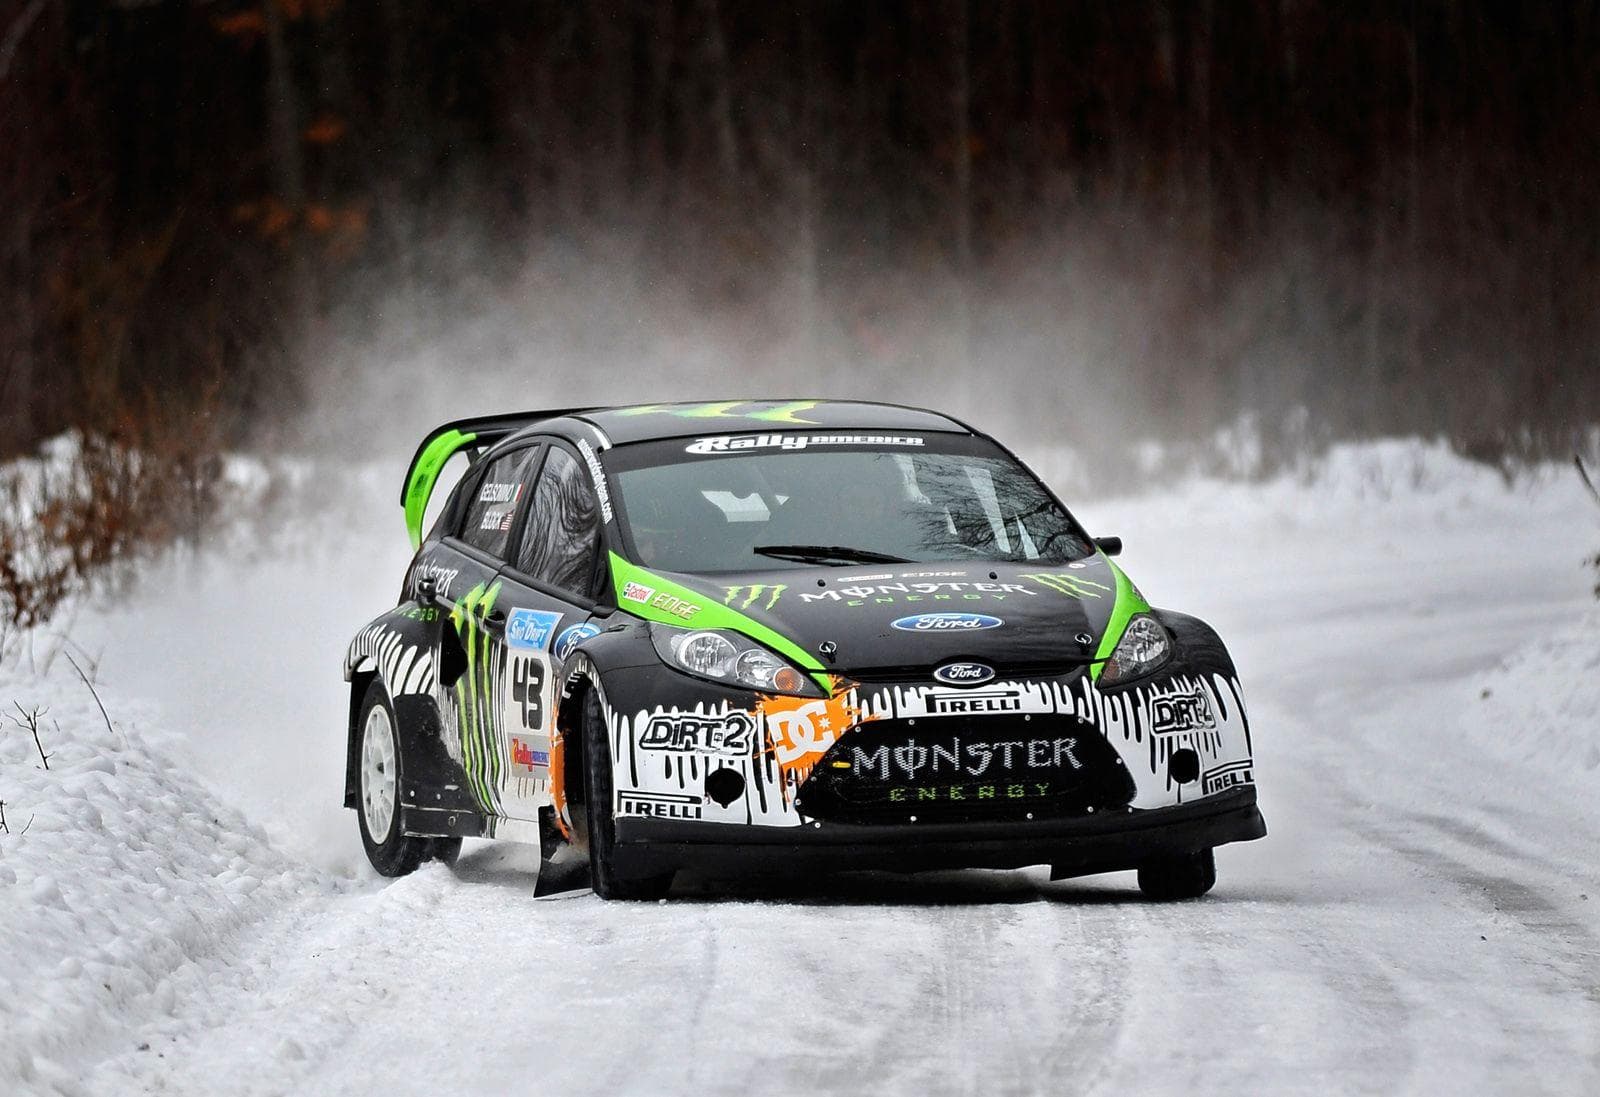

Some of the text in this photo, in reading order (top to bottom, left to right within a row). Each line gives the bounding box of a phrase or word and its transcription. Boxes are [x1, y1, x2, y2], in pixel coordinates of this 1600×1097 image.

[688, 434, 808, 451] Rally
[799, 582, 1037, 603] MONSTER
[848, 594, 1006, 606] ENERGY
[652, 592, 702, 620] EDGE
[915, 615, 982, 629] Ford
[949, 664, 982, 679] Ford
[512, 656, 545, 730] 43
[926, 690, 1021, 713] PIRELLI
[766, 700, 836, 765] DC
[851, 736, 1082, 780] MONSTER
[1202, 759, 1255, 795] PIRELL
[890, 782, 1050, 802] ENERGY
[617, 790, 702, 819] PIRELLI
